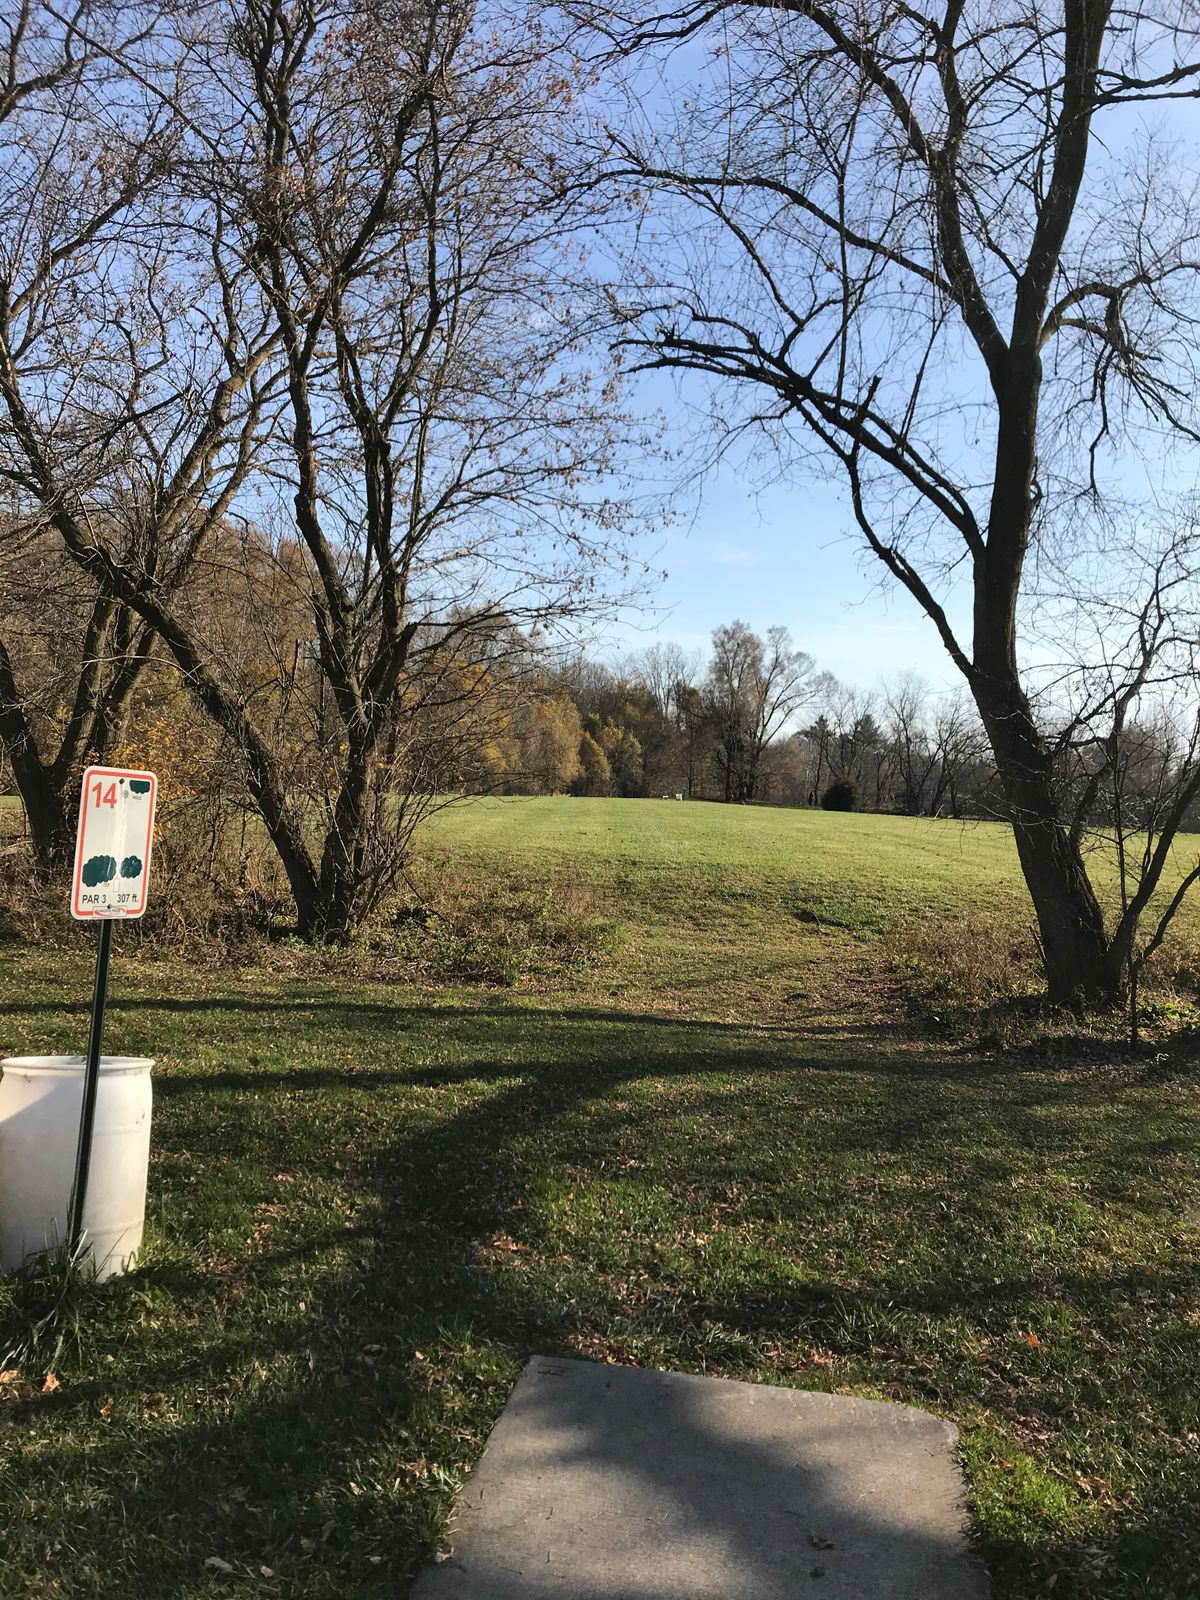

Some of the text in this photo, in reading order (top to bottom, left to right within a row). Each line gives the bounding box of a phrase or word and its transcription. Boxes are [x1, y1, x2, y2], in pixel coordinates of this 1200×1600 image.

[92, 782, 117, 809] 14
[82, 894, 100, 904] PAR
[101, 894, 107, 904] 3
[116, 893, 130, 903] 307
